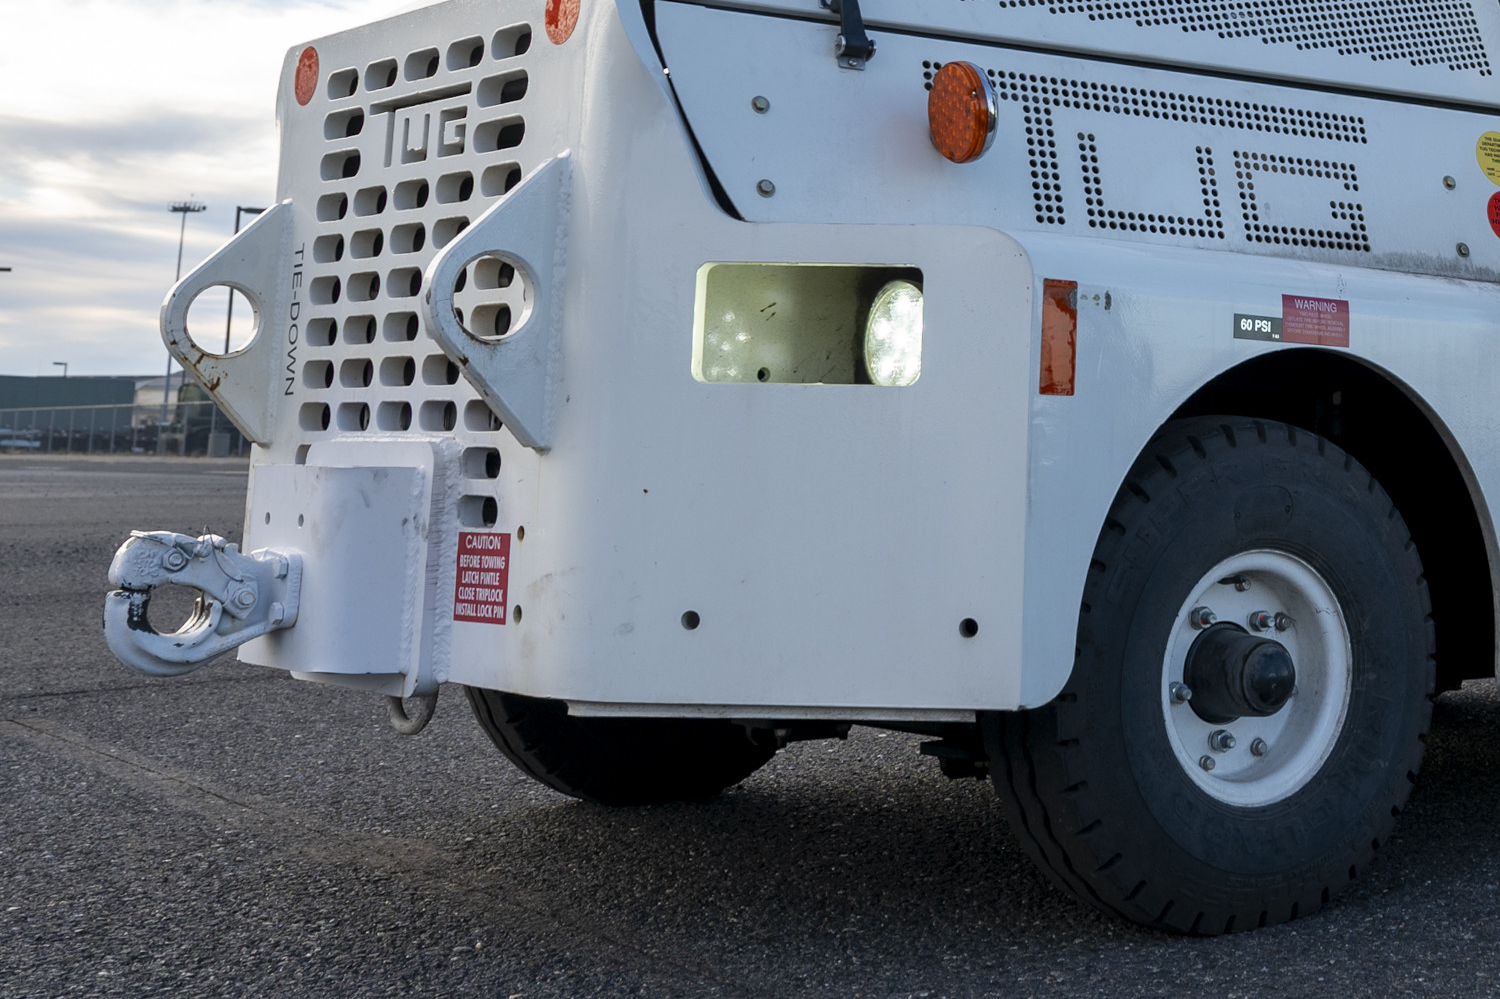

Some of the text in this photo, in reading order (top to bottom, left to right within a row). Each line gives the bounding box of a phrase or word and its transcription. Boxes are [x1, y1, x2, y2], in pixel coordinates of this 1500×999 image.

[369, 81, 472, 169] TUG
[922, 59, 1371, 252] TUG
[1295, 299, 1337, 313] WARNING
[285, 243, 304, 395] TIE-DOWN
[1241, 319, 1271, 332] 60 PSI
[466, 535, 501, 549] CAUTION
[460, 555, 505, 569] BEFORE TOWING
[462, 571, 500, 585] LATCH PINTLE
[458, 587, 503, 602] CLOSE TRIPLOCK
[456, 602, 504, 619] INSTALL LOCK PIN
